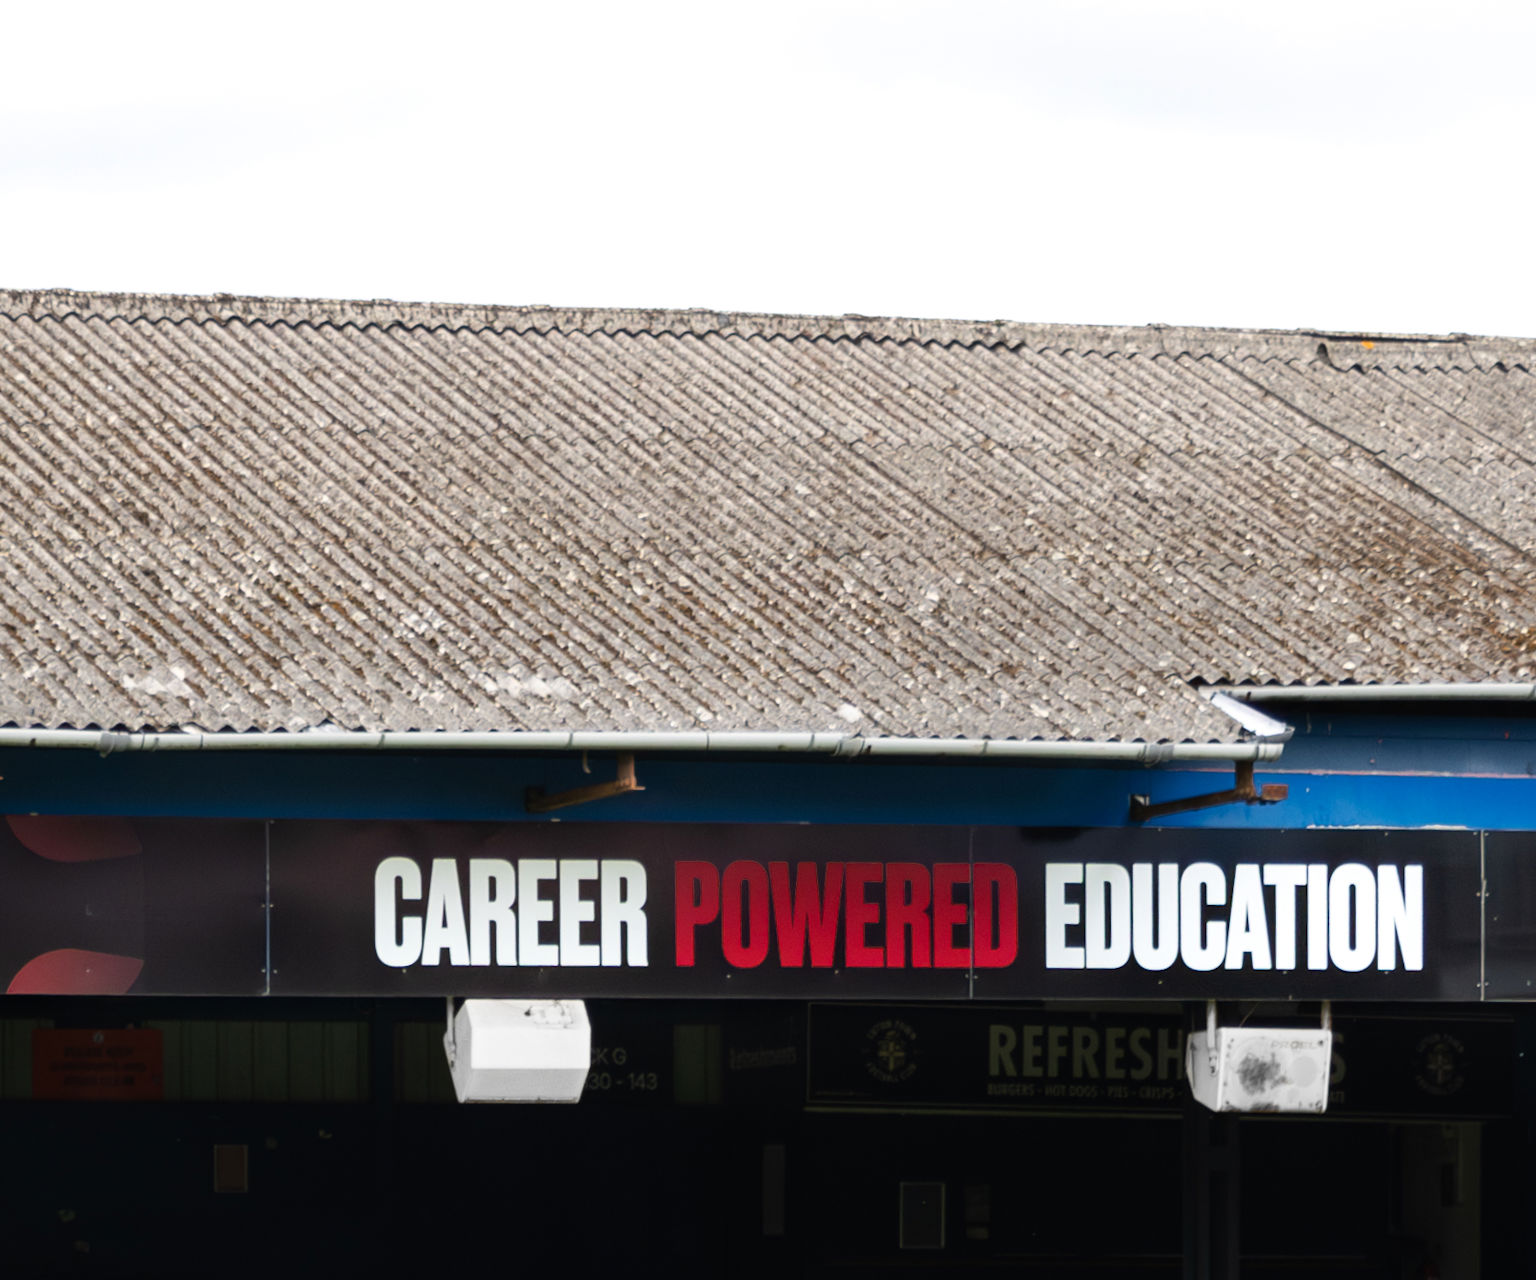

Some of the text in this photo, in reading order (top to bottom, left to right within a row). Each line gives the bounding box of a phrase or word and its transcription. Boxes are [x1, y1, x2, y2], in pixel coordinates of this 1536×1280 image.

[374, 857, 1424, 971] CAREER POWERED EDUCATION
[625, 1071, 657, 1090] 143
